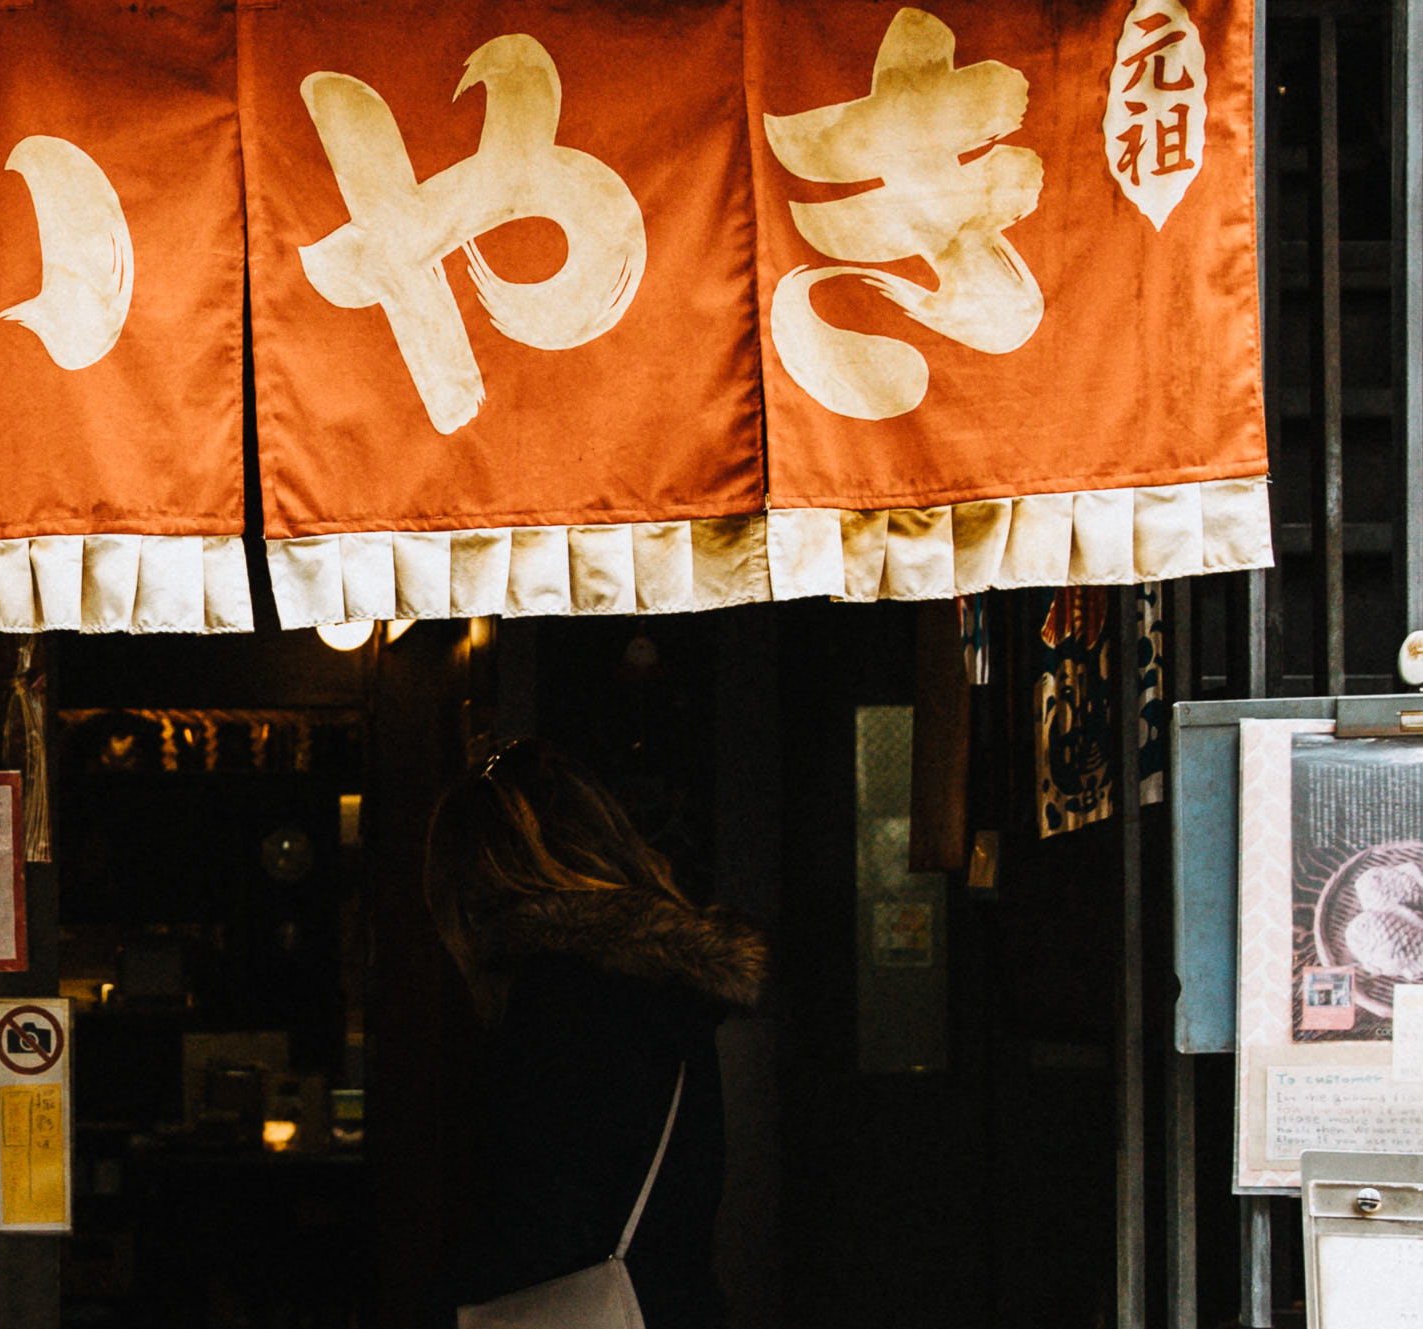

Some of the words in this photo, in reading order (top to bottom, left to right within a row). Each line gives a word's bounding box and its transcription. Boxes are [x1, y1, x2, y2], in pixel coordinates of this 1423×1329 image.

[1115, 12, 1195, 187] 元祖
[1275, 1073, 1296, 1085] To
[1305, 1073, 1383, 1085] customer
